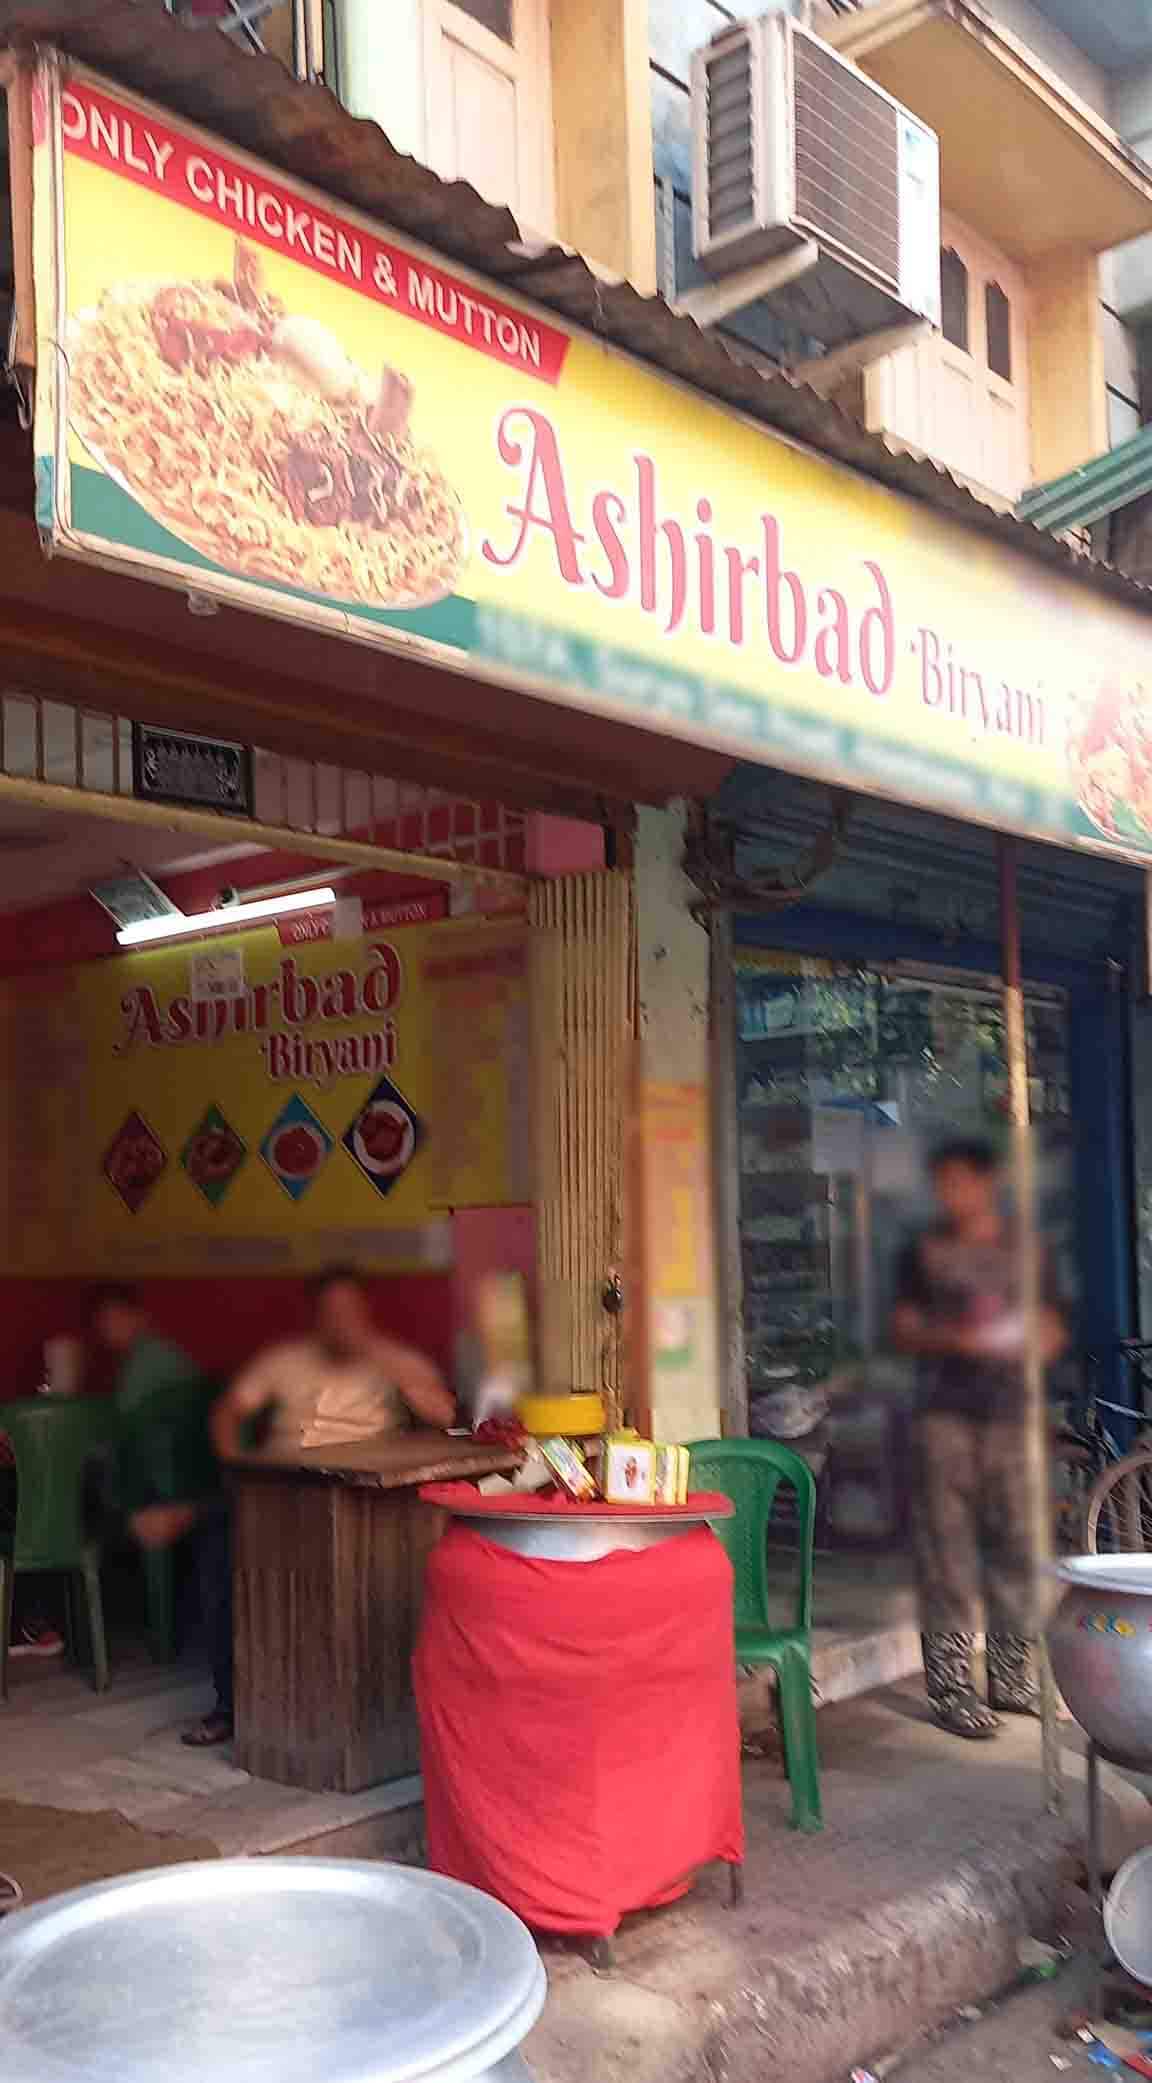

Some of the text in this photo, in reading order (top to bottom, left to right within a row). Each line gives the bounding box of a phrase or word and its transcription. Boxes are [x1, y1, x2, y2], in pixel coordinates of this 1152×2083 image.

[63, 89, 541, 368] ONLY CHICKEN & MUTTON
[482, 406, 895, 696] Ashirbad
[261, 1016, 397, 1089] Biryani
